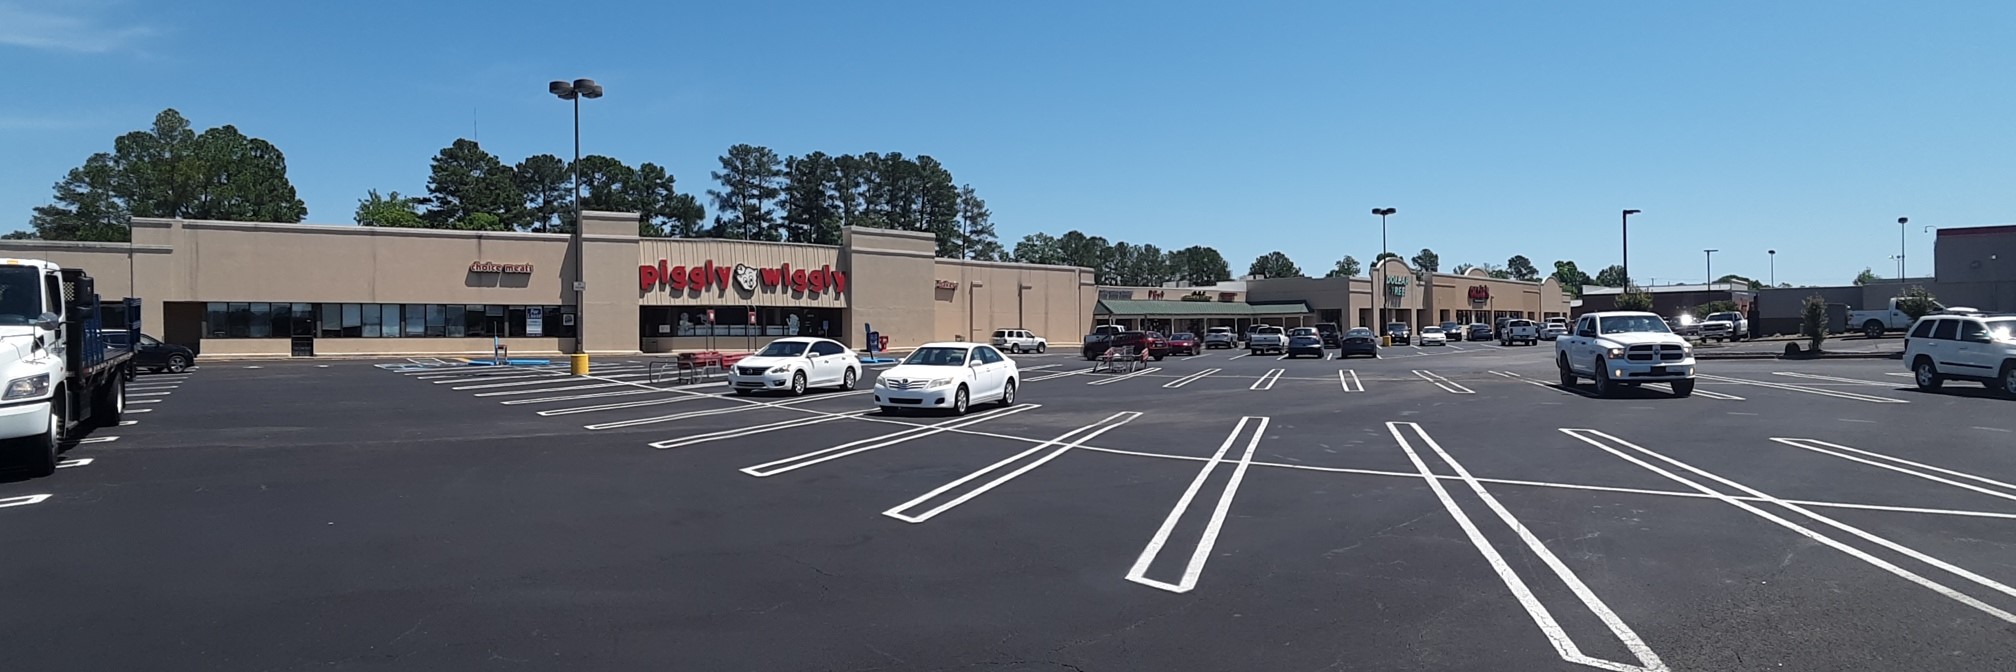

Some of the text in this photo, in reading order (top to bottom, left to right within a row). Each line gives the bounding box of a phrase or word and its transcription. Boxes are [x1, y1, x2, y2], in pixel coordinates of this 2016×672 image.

[470, 261, 534, 273] choice meats
[639, 259, 845, 293] piggly wiggly
